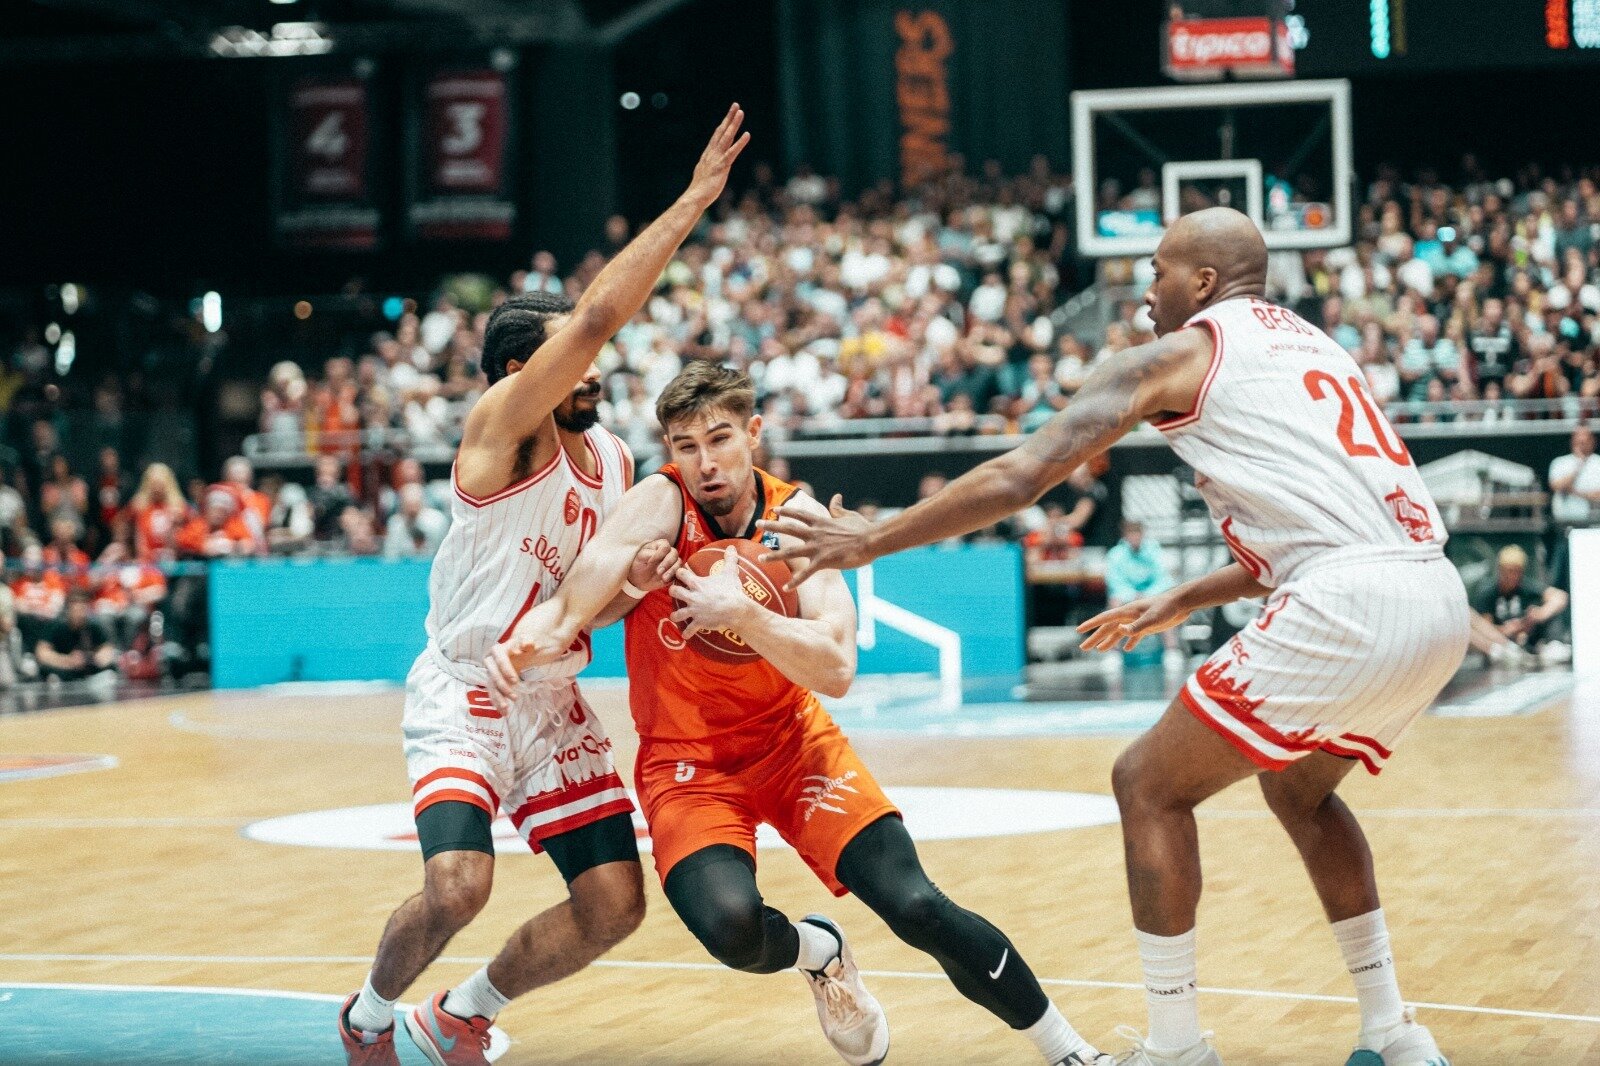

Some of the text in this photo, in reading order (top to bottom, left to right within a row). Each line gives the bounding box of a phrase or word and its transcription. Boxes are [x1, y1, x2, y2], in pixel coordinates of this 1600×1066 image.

[1172, 27, 1270, 61] tipico
[306, 111, 349, 157] 4
[441, 102, 486, 154] 3
[1252, 308, 1313, 336] BESS
[1303, 370, 1411, 466] 20
[520, 535, 564, 582] s.Oliv
[743, 575, 768, 602] BBL
[674, 760, 696, 783] 5
